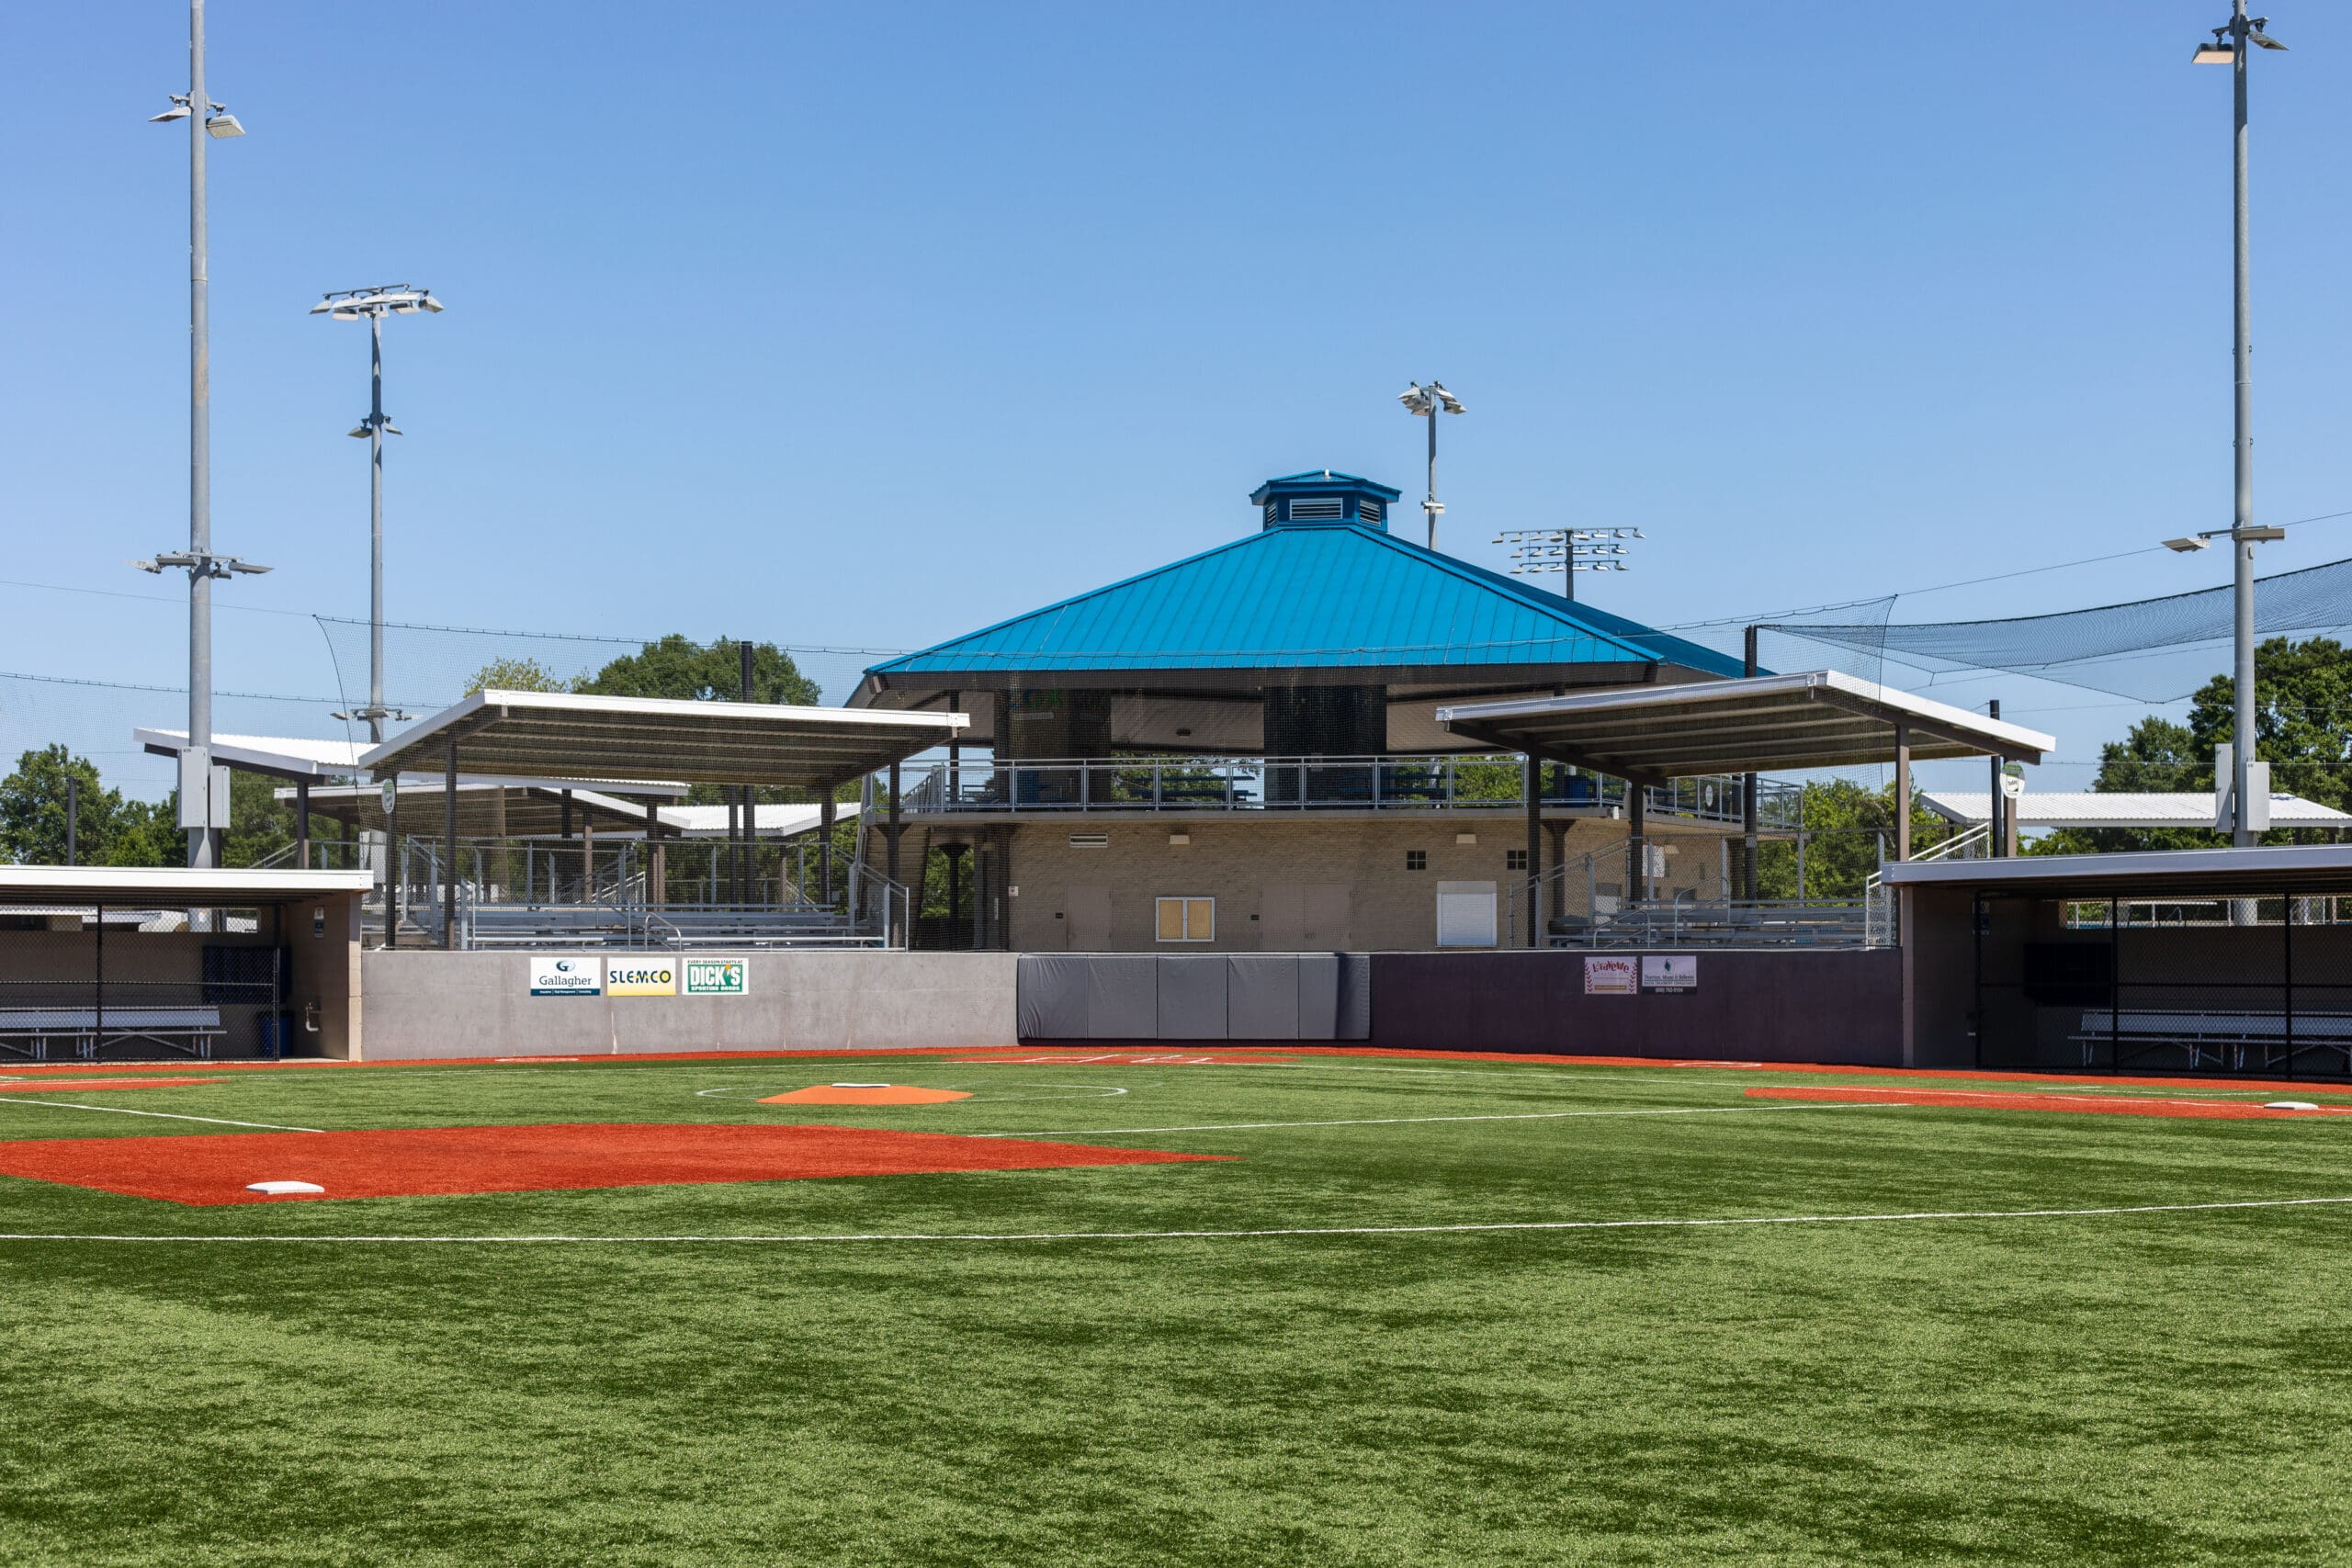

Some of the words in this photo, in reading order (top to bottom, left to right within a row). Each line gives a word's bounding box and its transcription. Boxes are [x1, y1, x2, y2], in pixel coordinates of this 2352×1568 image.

[538, 976, 593, 987] Gallagher
[609, 970, 672, 984] SLEMCO
[690, 965, 741, 986] DICK'S
